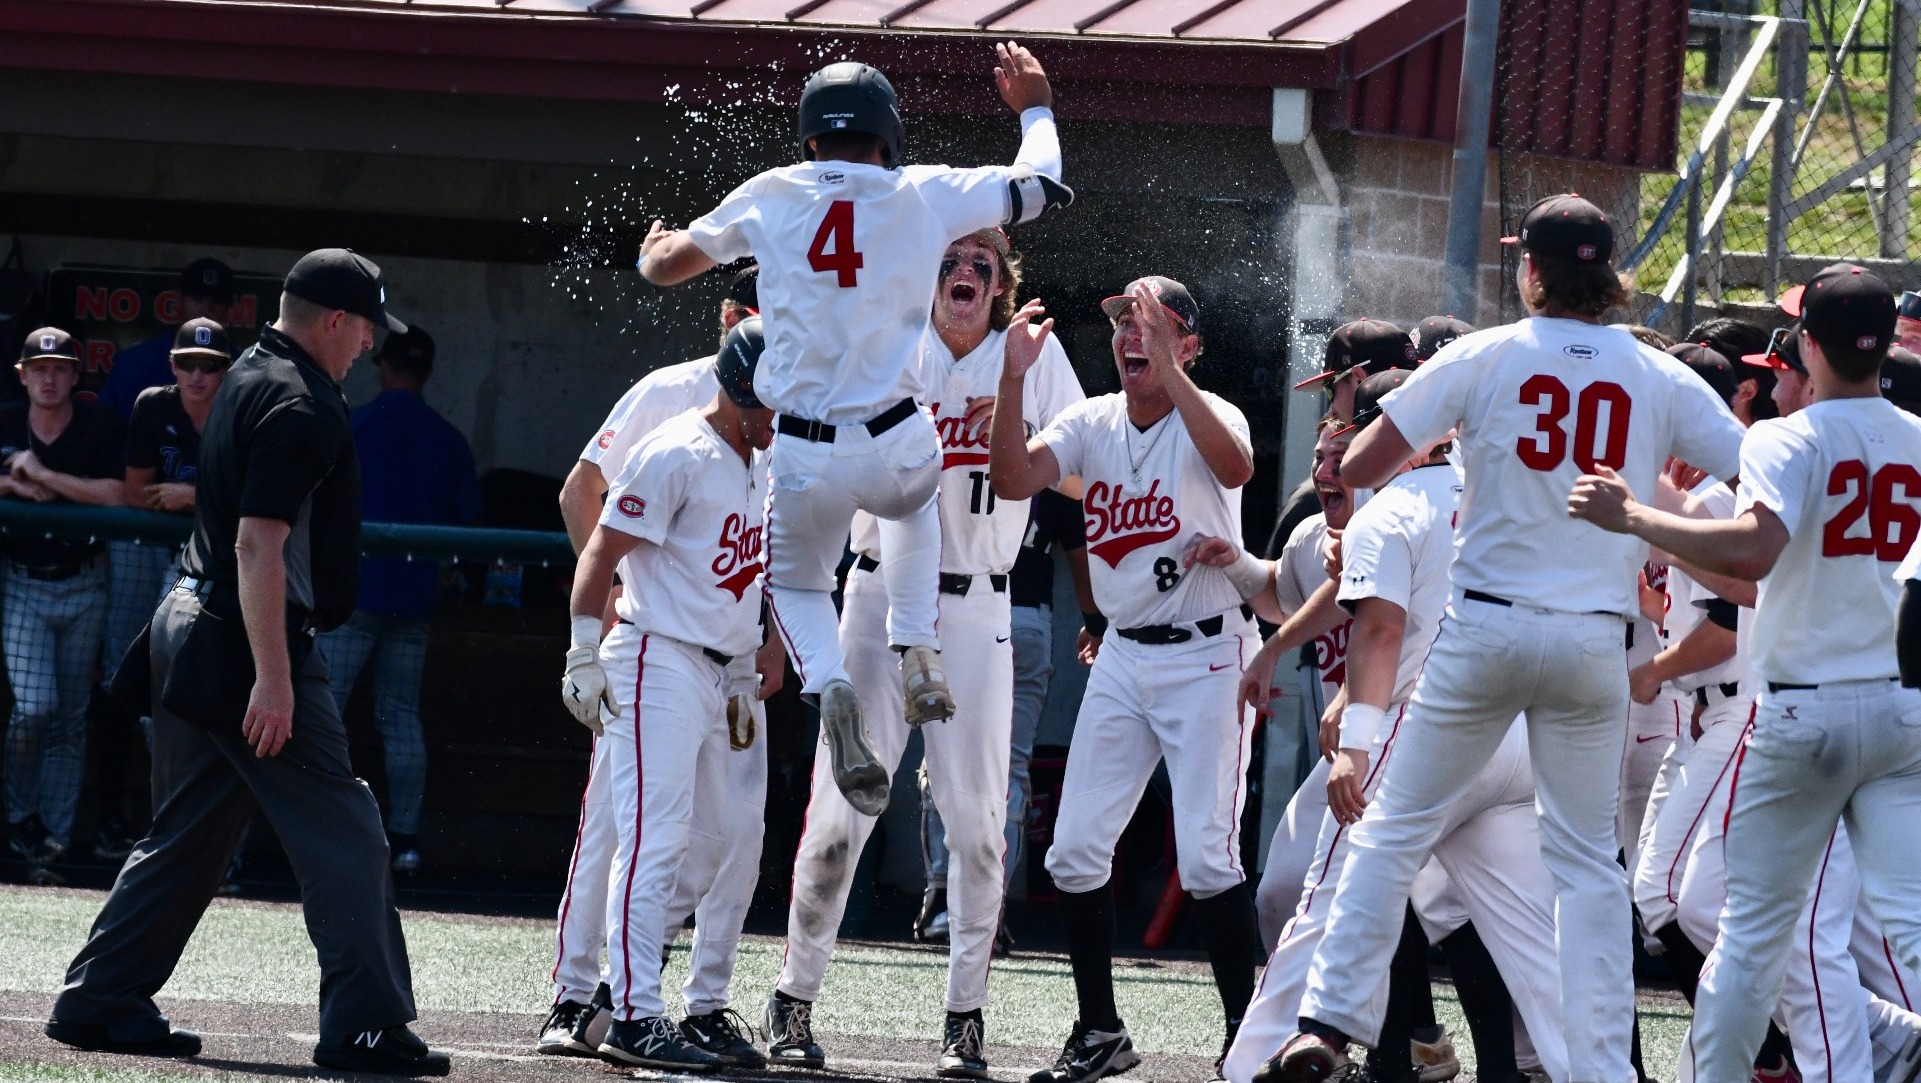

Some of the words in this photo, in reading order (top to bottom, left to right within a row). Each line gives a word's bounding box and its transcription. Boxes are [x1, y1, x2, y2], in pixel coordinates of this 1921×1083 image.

[807, 201, 863, 288] 4
[75, 285, 141, 322] NO
[154, 290, 258, 329] GM
[1516, 374, 1632, 475] 30
[1084, 479, 1180, 543] State
[1822, 459, 1921, 562] 26
[1153, 557, 1180, 593] 8
